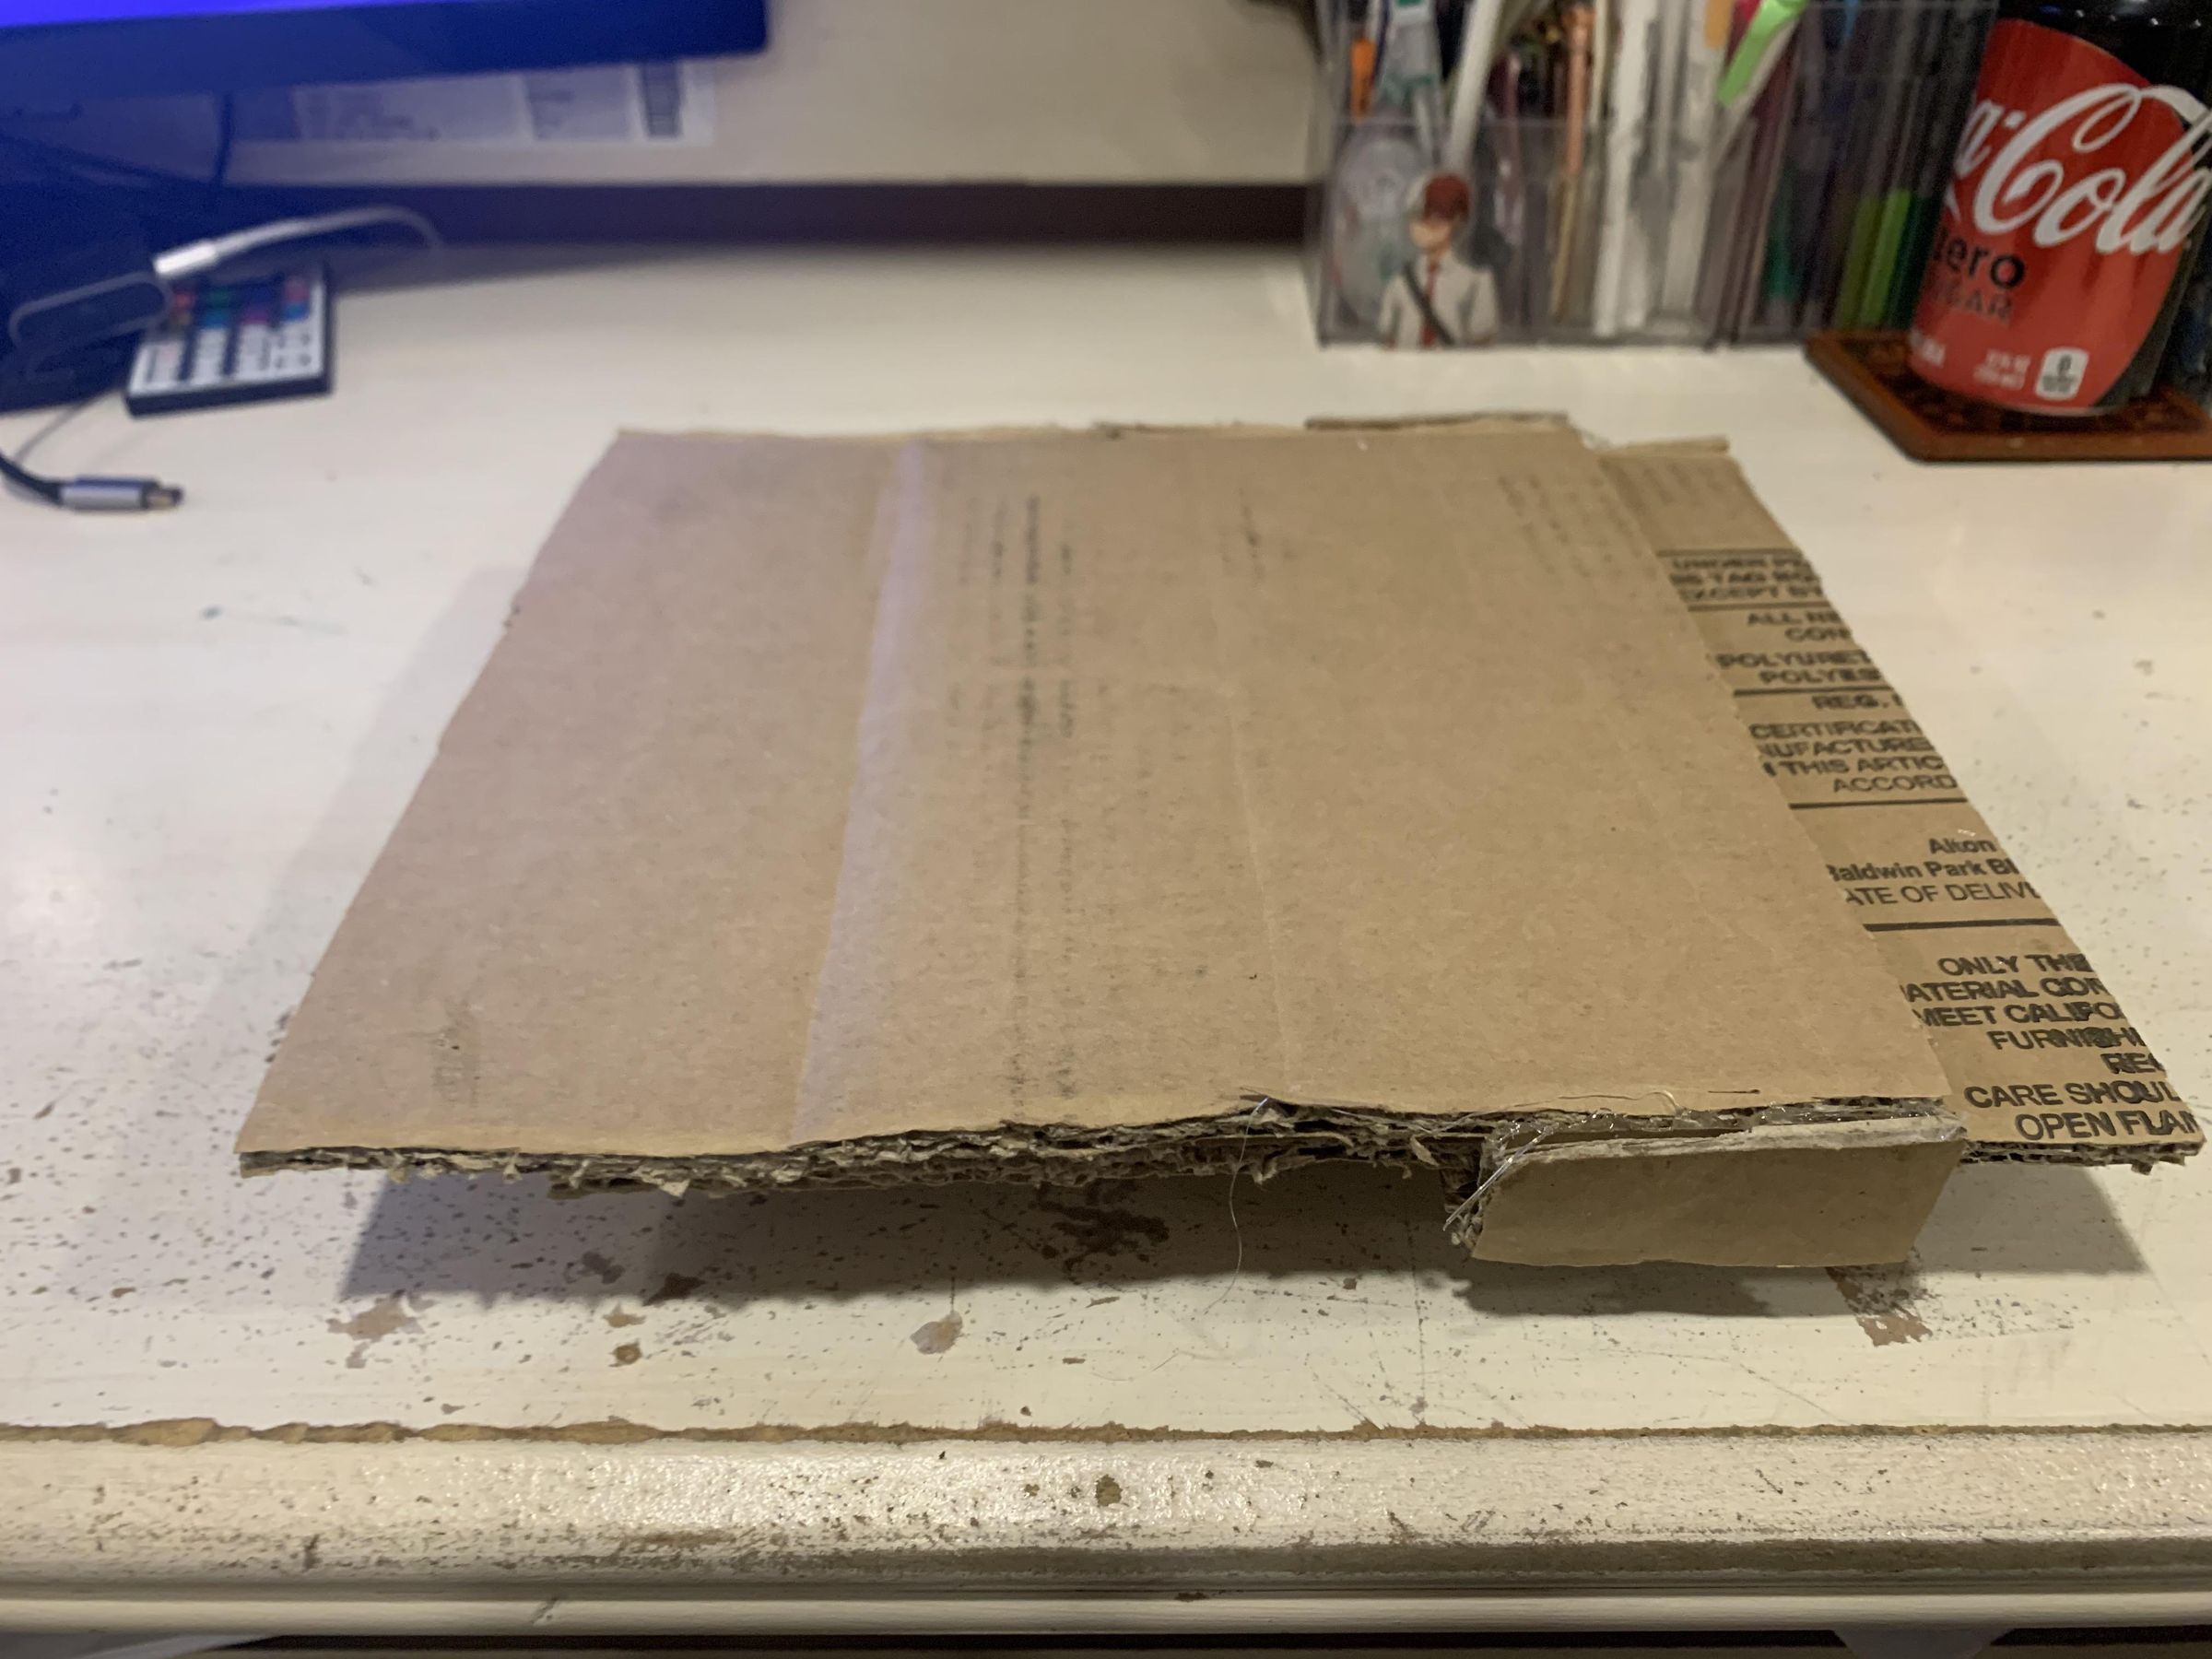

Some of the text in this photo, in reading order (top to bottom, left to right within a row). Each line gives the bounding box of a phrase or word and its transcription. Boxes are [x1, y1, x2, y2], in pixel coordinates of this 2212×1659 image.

[1833, 774, 1959, 794] ACCORD
[1928, 838, 1996, 854] Alton
[1924, 860, 1987, 877] Park
[1900, 885, 1939, 904] OF
[1936, 955, 2019, 976] ONLY
[1899, 979, 2041, 1003] ATERIAL
[2003, 1001, 2127, 1024] CALIFO
[1963, 1080, 2183, 1109] CARE SHOUL
[2013, 1111, 2118, 1141] OPEN
